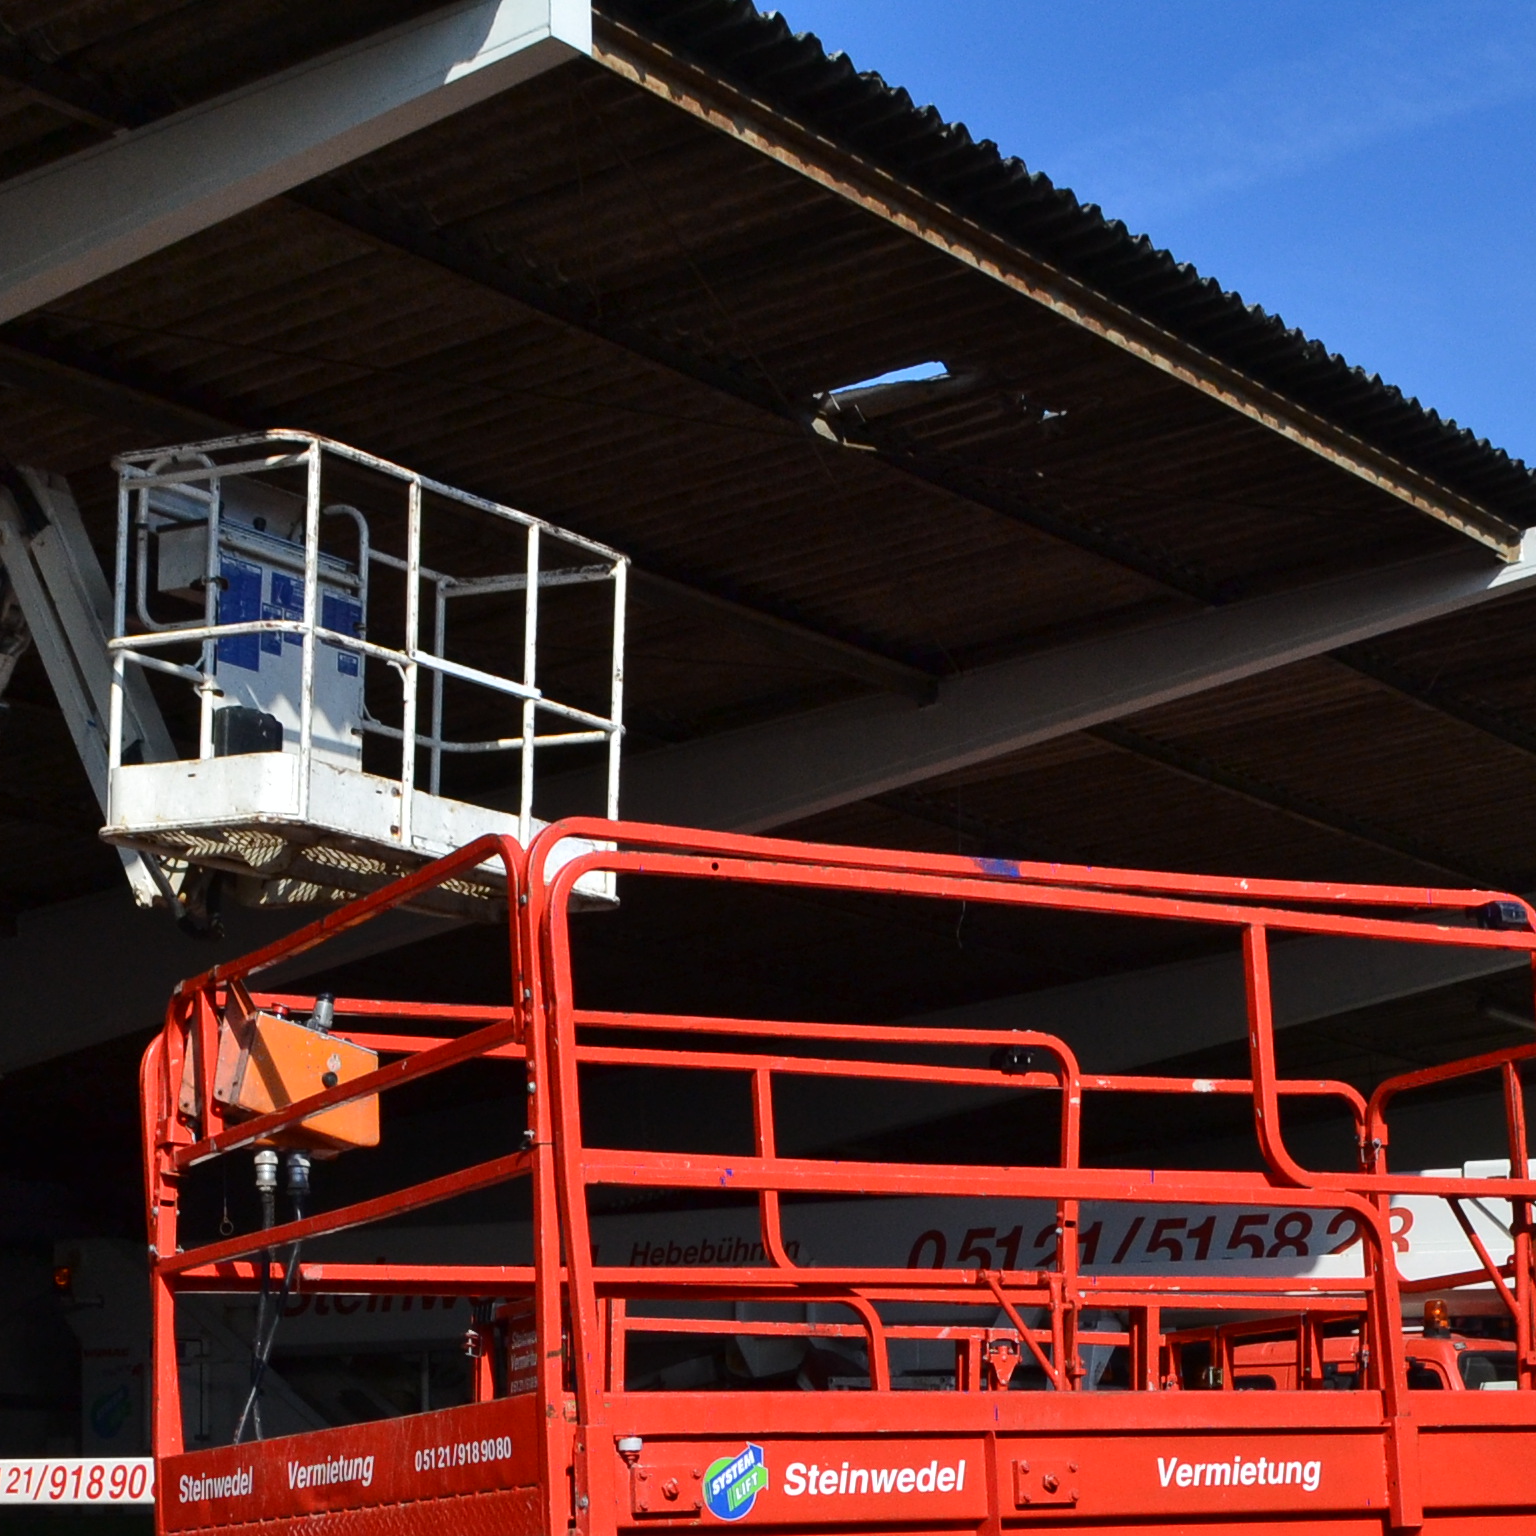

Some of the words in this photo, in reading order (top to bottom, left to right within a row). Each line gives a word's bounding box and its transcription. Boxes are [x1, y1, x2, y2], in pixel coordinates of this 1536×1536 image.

[629, 1236, 800, 1267] Hebebühnn
[179, 1466, 253, 1503] Steinwedel
[287, 1453, 374, 1490] Vermietung
[415, 1436, 512, 1473] 05121/9189080
[712, 1449, 755, 1496] SYSTEM
[735, 1471, 758, 1500] LIFT
[783, 1460, 966, 1496] Steinwedel
[1157, 1455, 1322, 1492] Vermietung
